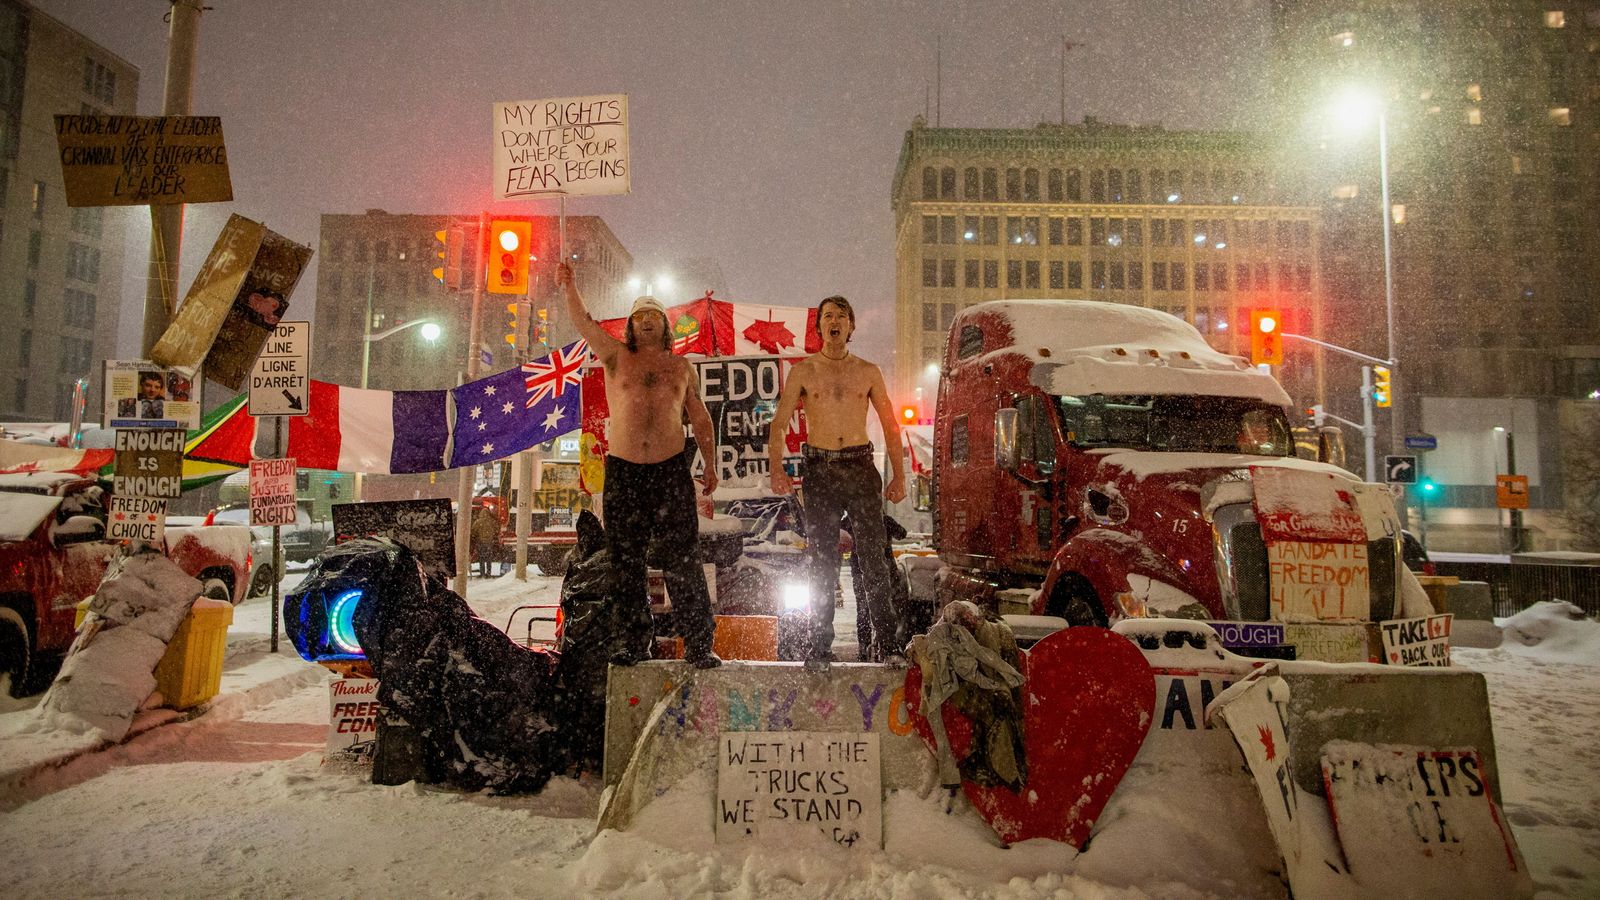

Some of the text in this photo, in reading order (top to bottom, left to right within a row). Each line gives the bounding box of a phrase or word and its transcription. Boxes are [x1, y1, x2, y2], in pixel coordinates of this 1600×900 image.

[504, 100, 621, 126] MY RIGHTS
[57, 115, 122, 135] TRUDEAU
[173, 116, 221, 136] LEADER
[562, 125, 595, 145] END
[121, 147, 149, 165] VAX
[509, 138, 617, 164] WHERE YOUR
[506, 159, 625, 193] FEAR BEGINS
[113, 176, 186, 197] LEADER
[273, 326, 296, 338] TOP
[267, 342, 293, 353] LINE
[262, 361, 296, 372] LIGNE
[253, 374, 304, 388] D'ARRÊT
[699, 361, 779, 401] EDO
[115, 431, 185, 451] ENOUGH
[138, 458, 158, 471] IS
[251, 460, 296, 477] FREEDOM
[114, 477, 181, 497] ENOUGH
[252, 481, 289, 496] JUSTICE
[111, 498, 166, 514] FREEDOM
[252, 505, 296, 524] RIGHTS
[112, 523, 157, 540] CHOICE
[1172, 519, 1188, 533] 15
[1270, 562, 1368, 590] FREEDOM
[1271, 588, 1285, 613] 4
[1217, 624, 1281, 645] NOUGH
[1383, 620, 1428, 647] TAKE
[1402, 646, 1446, 663] BACK OUR
[333, 702, 381, 718] FREE
[337, 718, 377, 733] CON
[728, 740, 868, 765] WITH THE
[749, 770, 849, 795] TRUCKS
[722, 799, 862, 823] WE STAND
